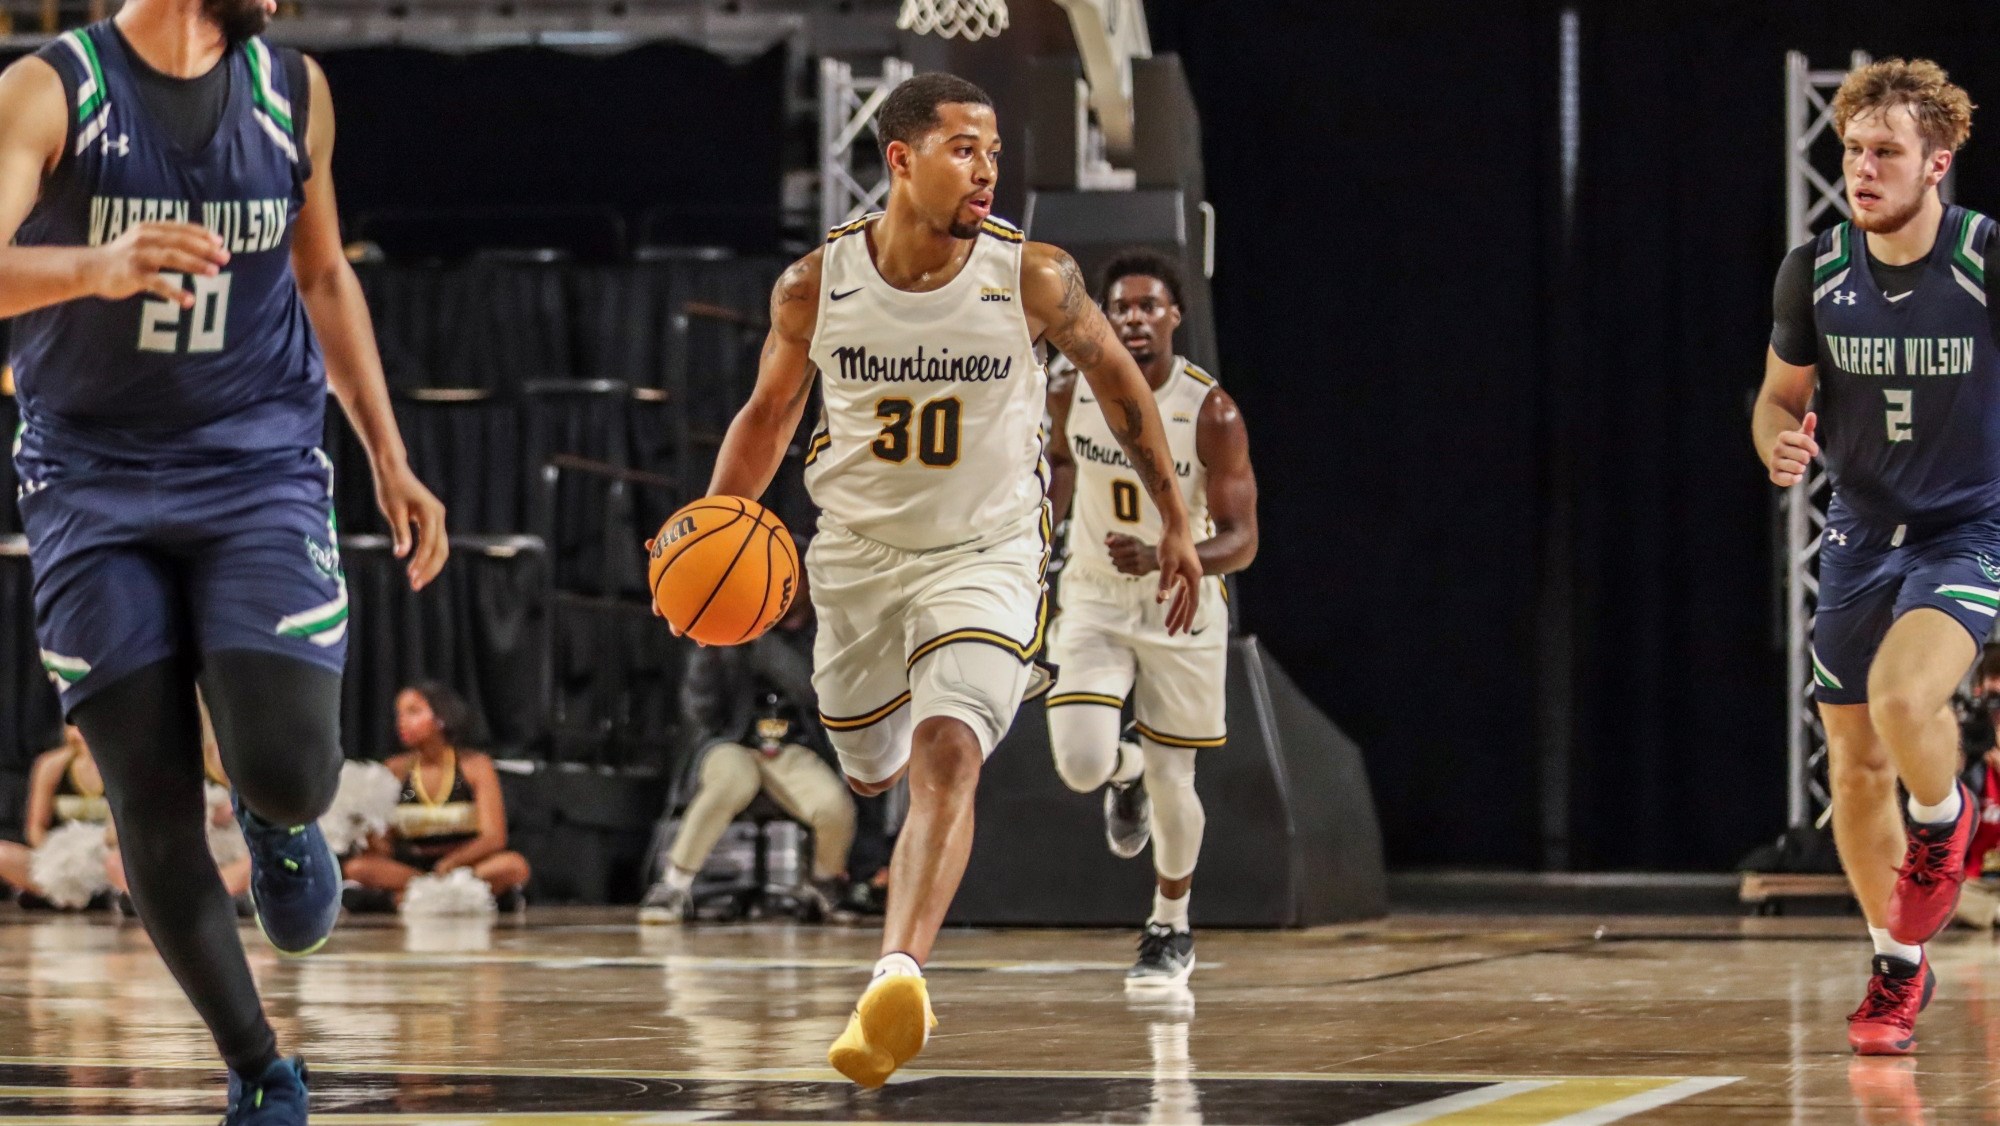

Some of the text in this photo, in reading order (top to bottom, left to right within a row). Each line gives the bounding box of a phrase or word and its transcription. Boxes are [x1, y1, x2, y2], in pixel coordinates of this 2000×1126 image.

[202, 197, 288, 254] WILSON
[137, 271, 232, 352] 20
[980, 286, 1012, 302] SBC
[831, 345, 1012, 382] Mountaineers
[1825, 334, 1974, 376] WARREN WILSON
[870, 395, 963, 470] 30
[1883, 389, 1913, 442] 2
[1073, 434, 1191, 477] Mounrs
[1112, 479, 1140, 524] 0
[651, 515, 698, 559] Wil
